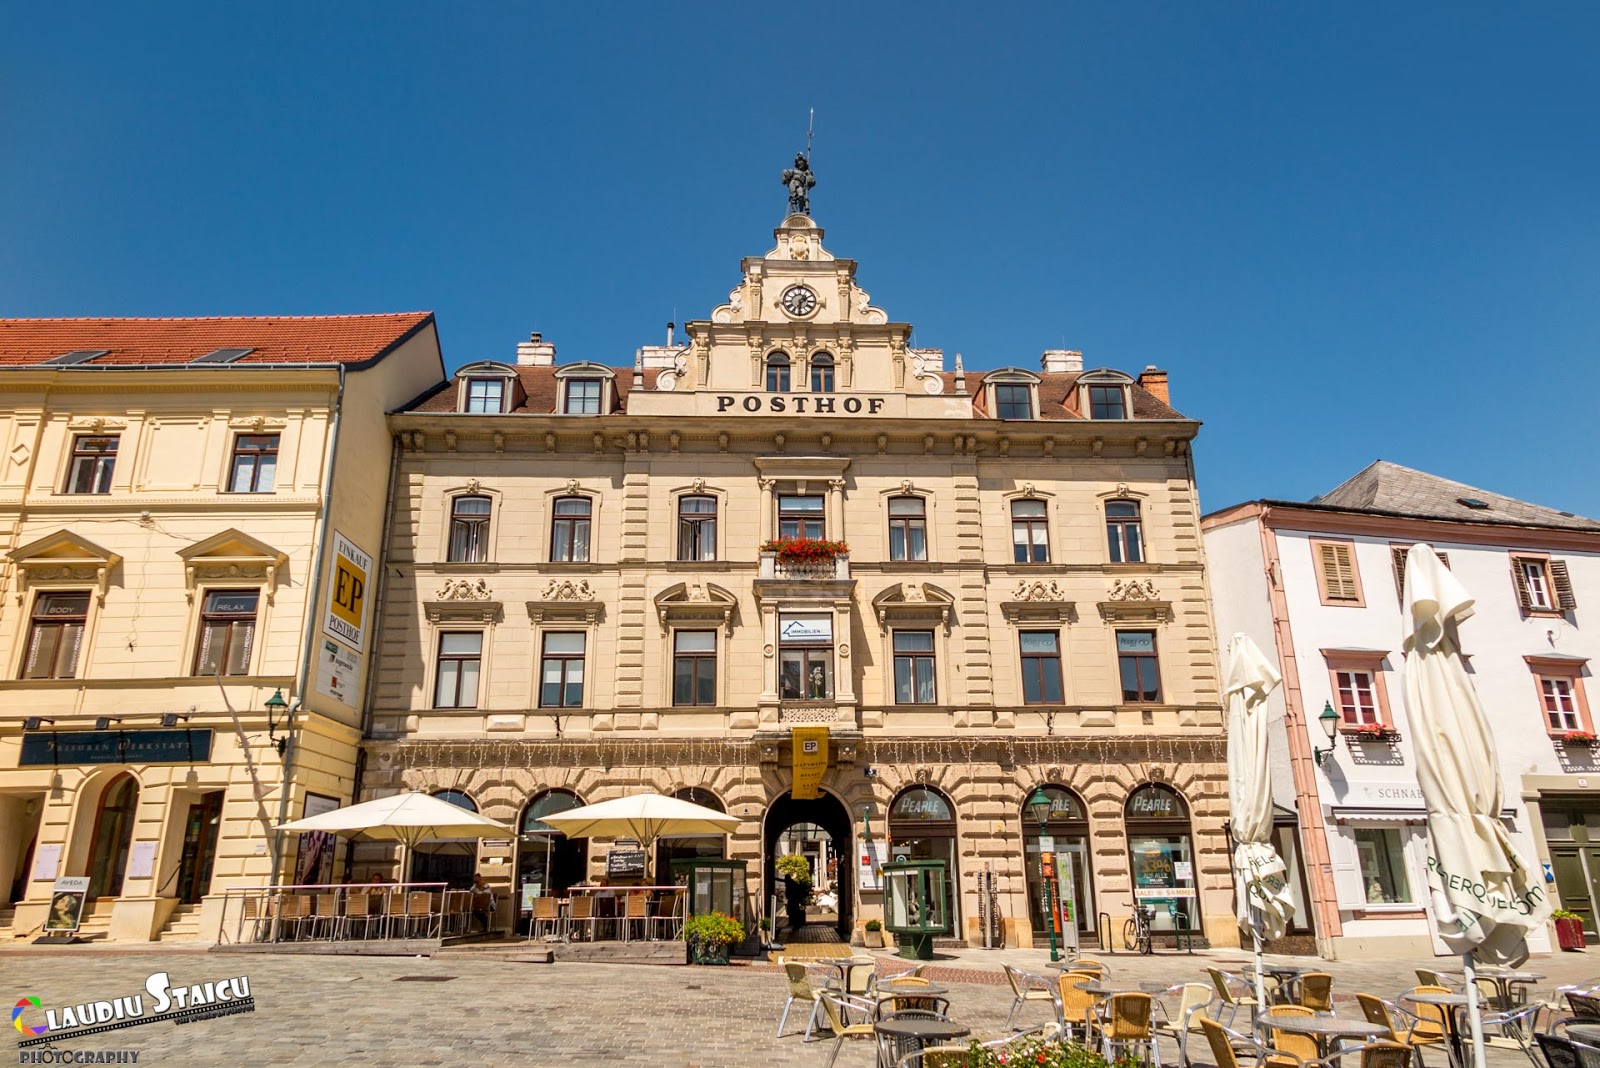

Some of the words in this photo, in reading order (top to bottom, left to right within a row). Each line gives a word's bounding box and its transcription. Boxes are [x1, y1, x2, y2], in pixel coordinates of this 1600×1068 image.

[716, 396, 885, 414] POSTHOF
[338, 540, 368, 569] EINKAUF
[334, 565, 364, 614] EP
[49, 606, 75, 614] BODY
[217, 603, 246, 611] RELAX
[329, 614, 361, 642] POSTHOF
[804, 742, 816, 751] EP
[1378, 788, 1425, 799] SCHNAB
[901, 797, 939, 813] PEARLE
[1050, 799, 1071, 811] RLE
[1134, 796, 1172, 811] PEARLE
